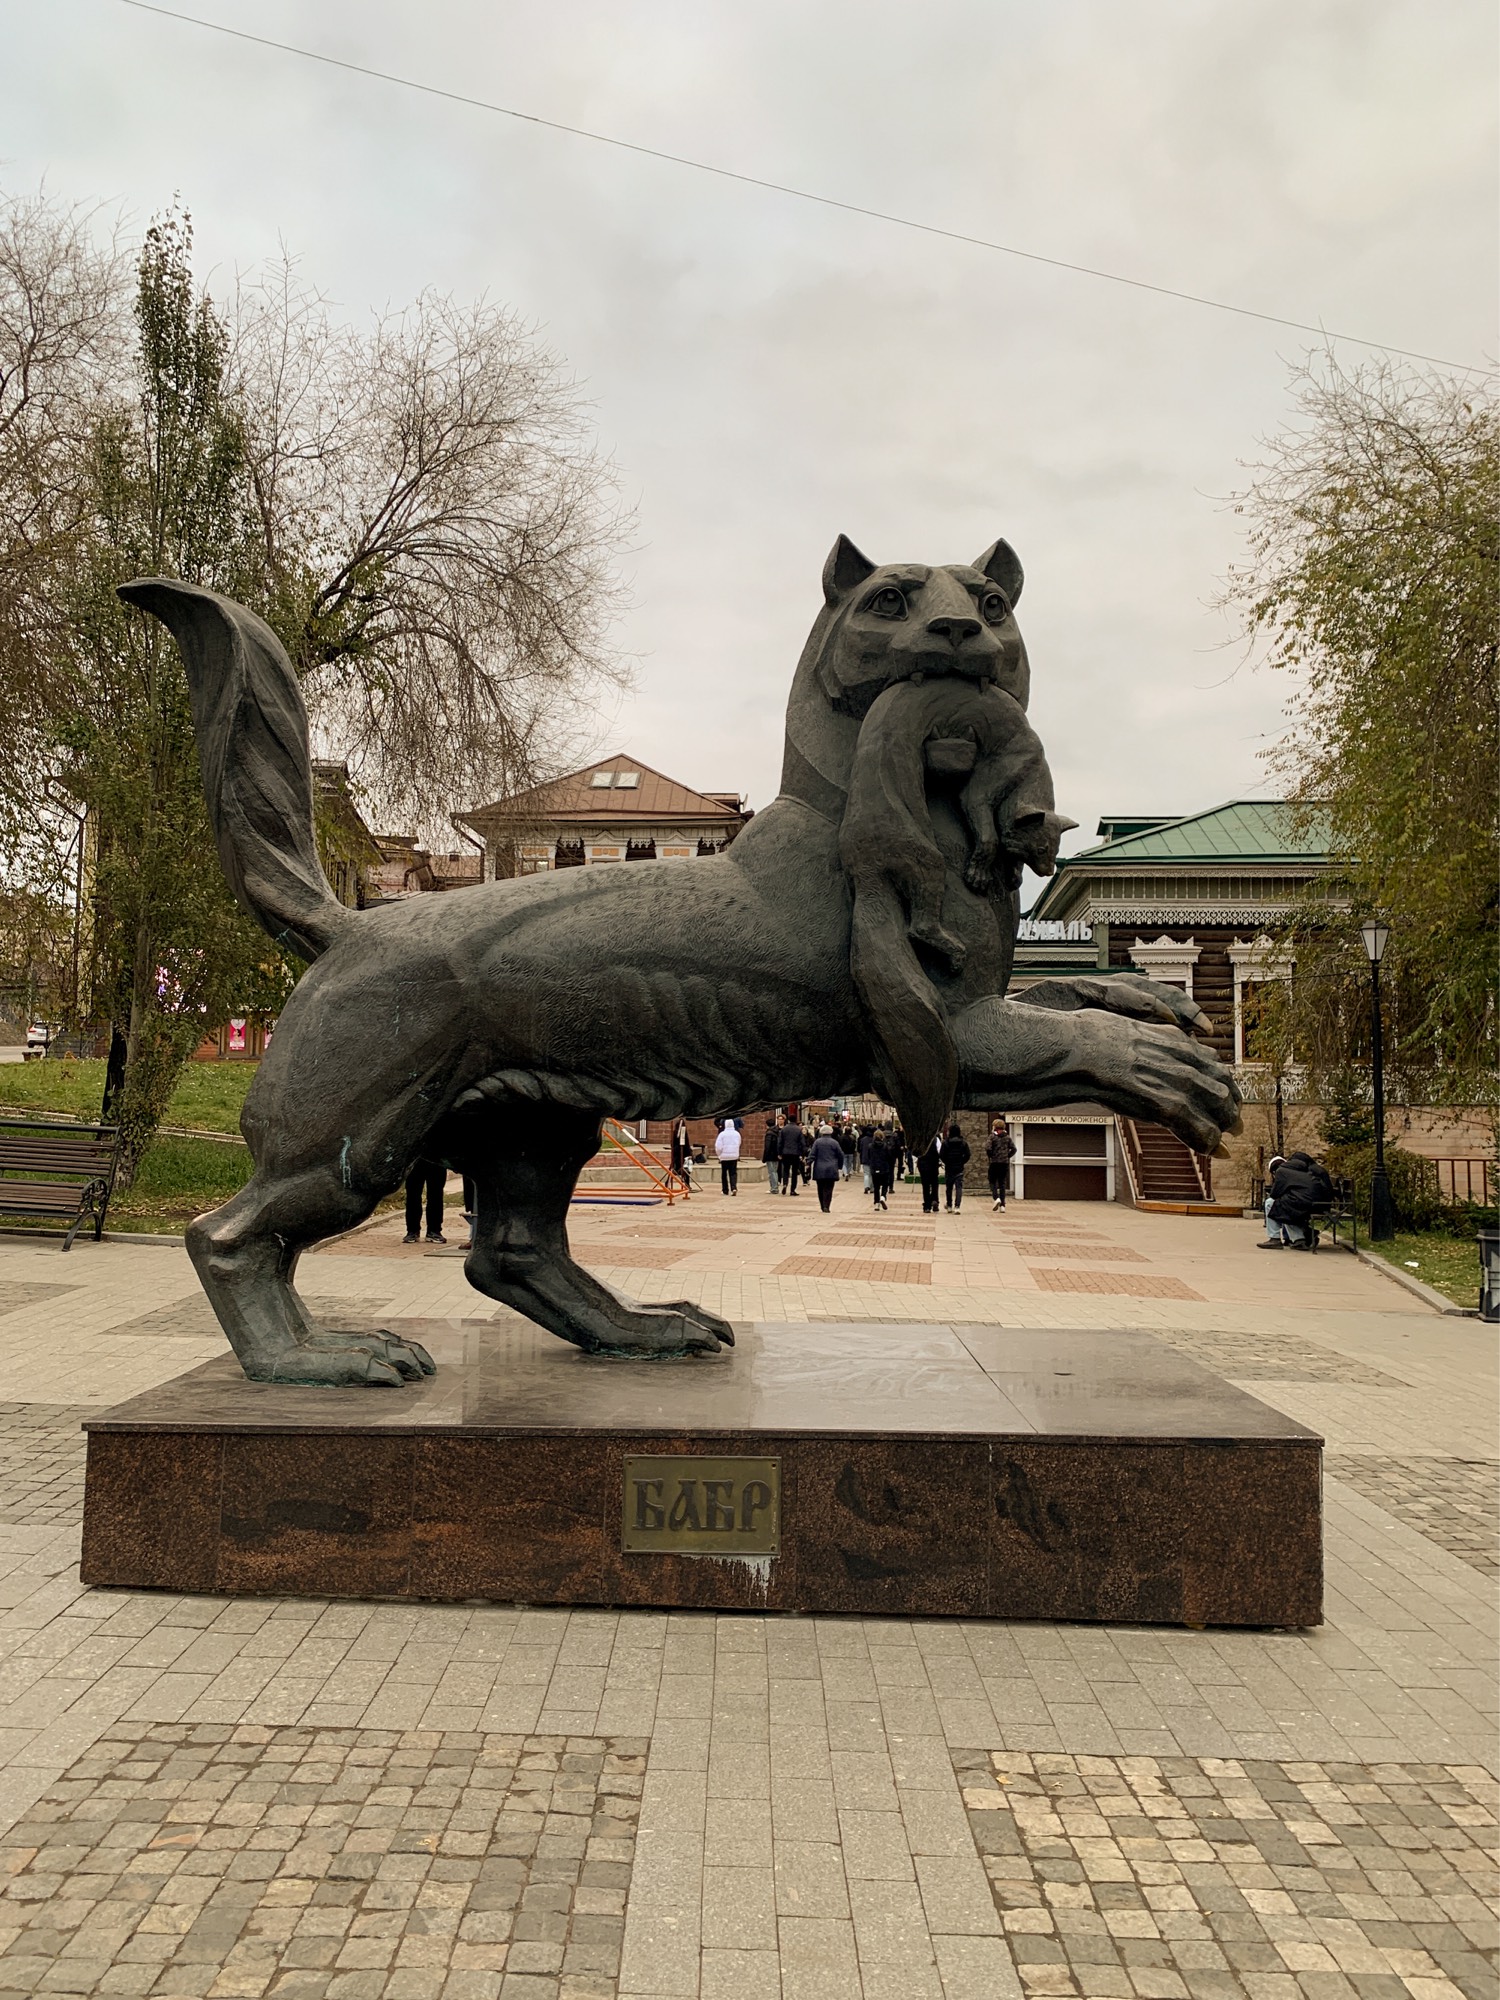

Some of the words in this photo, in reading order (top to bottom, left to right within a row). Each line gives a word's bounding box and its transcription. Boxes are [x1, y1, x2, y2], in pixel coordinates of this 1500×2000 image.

[1011, 1115, 1047, 1123] ХОТ-ДОГИ
[1060, 1116, 1108, 1124] МОРОЖЕНОЕ
[632, 1478, 772, 1531] БАБР
